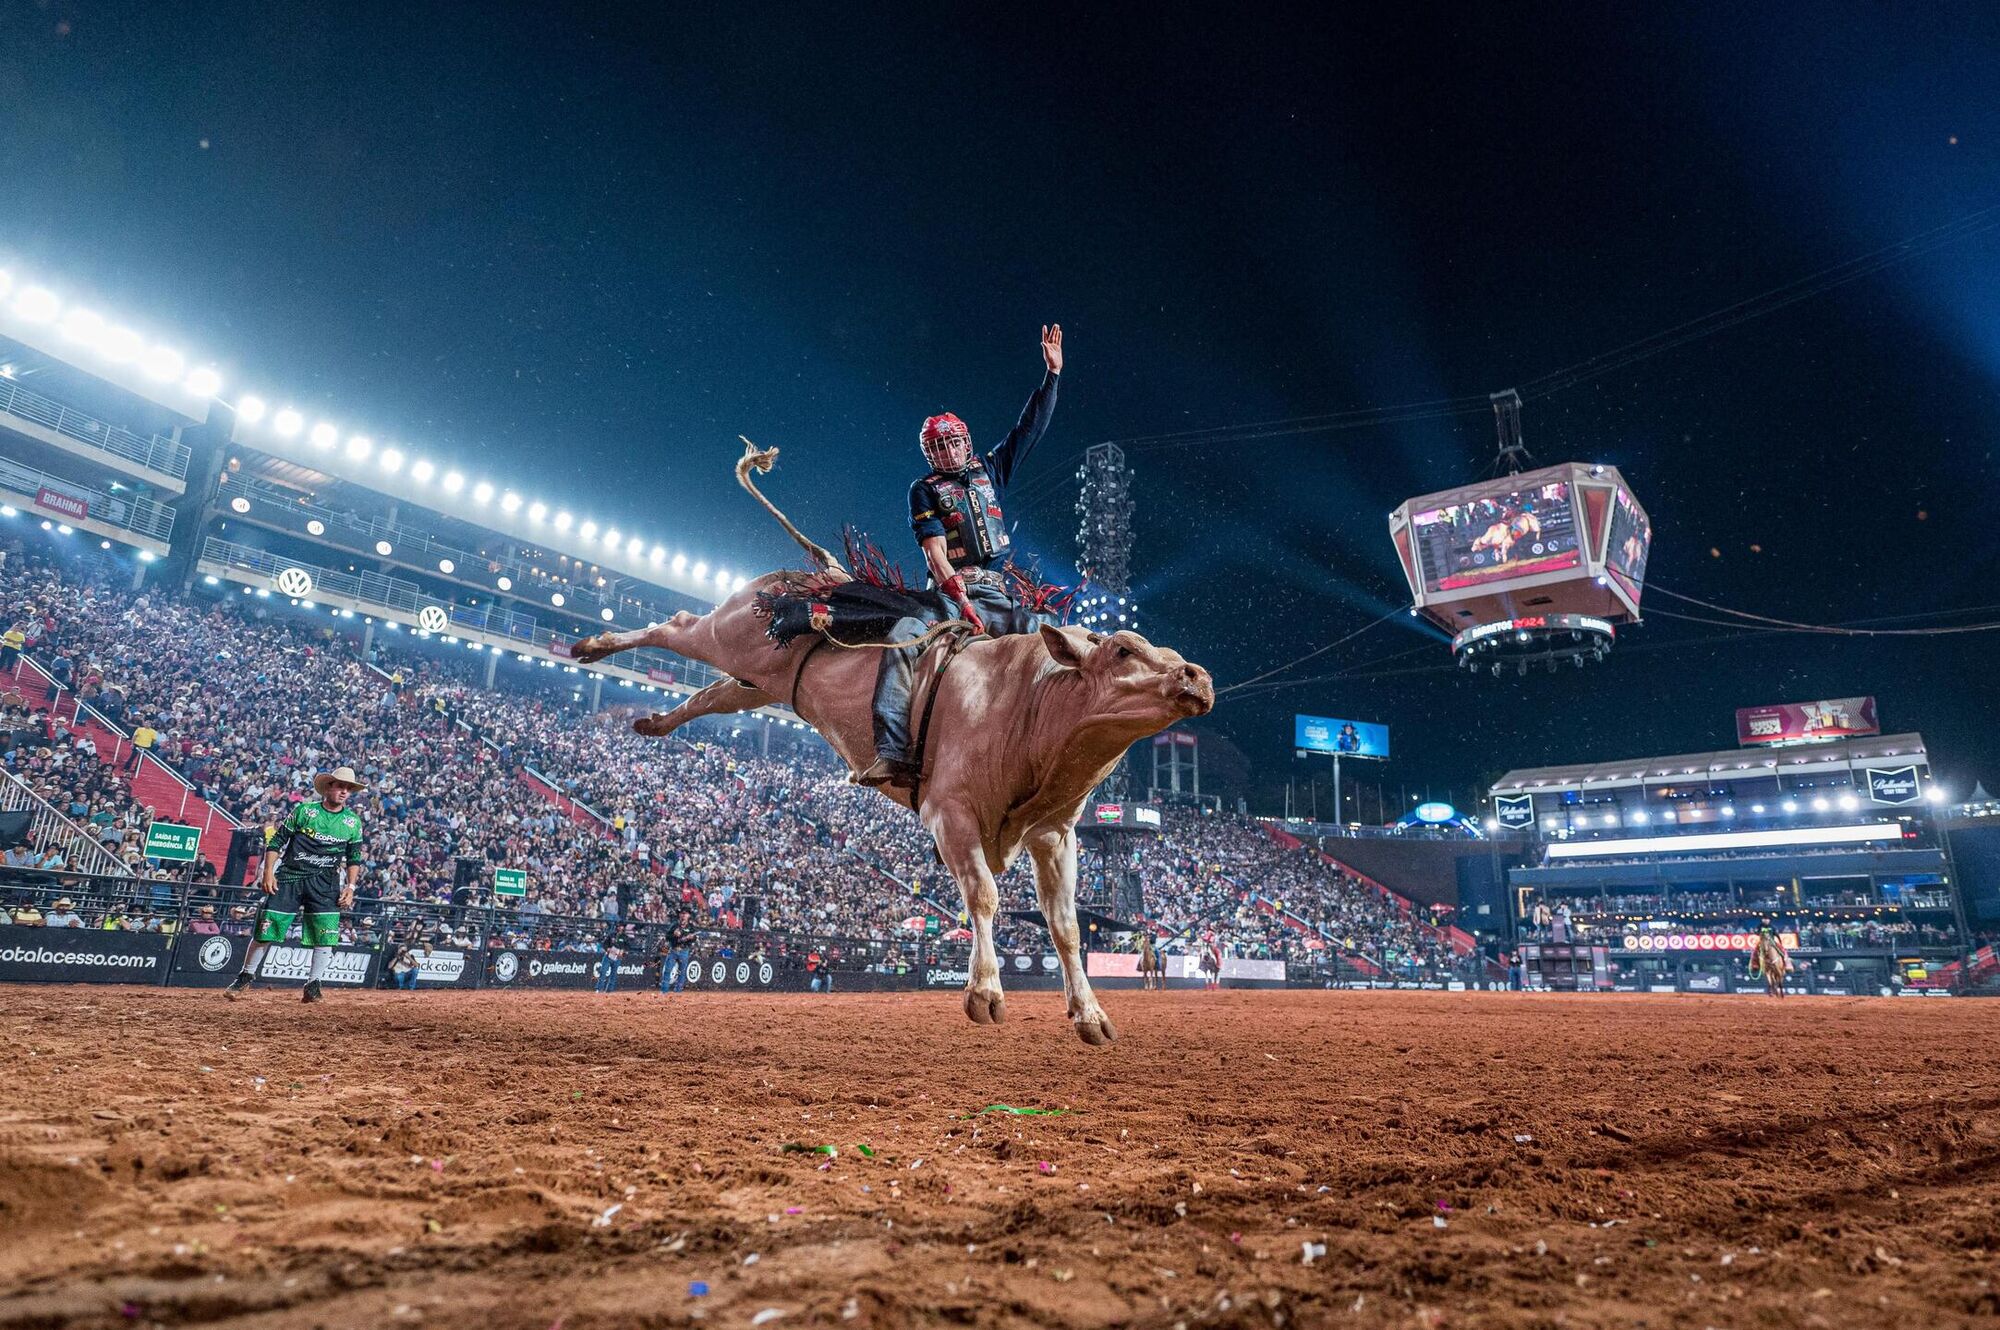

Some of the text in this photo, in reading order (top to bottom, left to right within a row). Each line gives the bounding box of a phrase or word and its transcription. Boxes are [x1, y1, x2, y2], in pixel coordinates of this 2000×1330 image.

[43, 492, 83, 515] BRAHMA
[314, 832, 347, 843] EcoPow
[263, 945, 372, 972] IQUAMI
[435, 961, 463, 974] color
[542, 961, 587, 976] galera.bet
[605, 963, 644, 977] gera.bet
[935, 969, 970, 982] EcoPow
